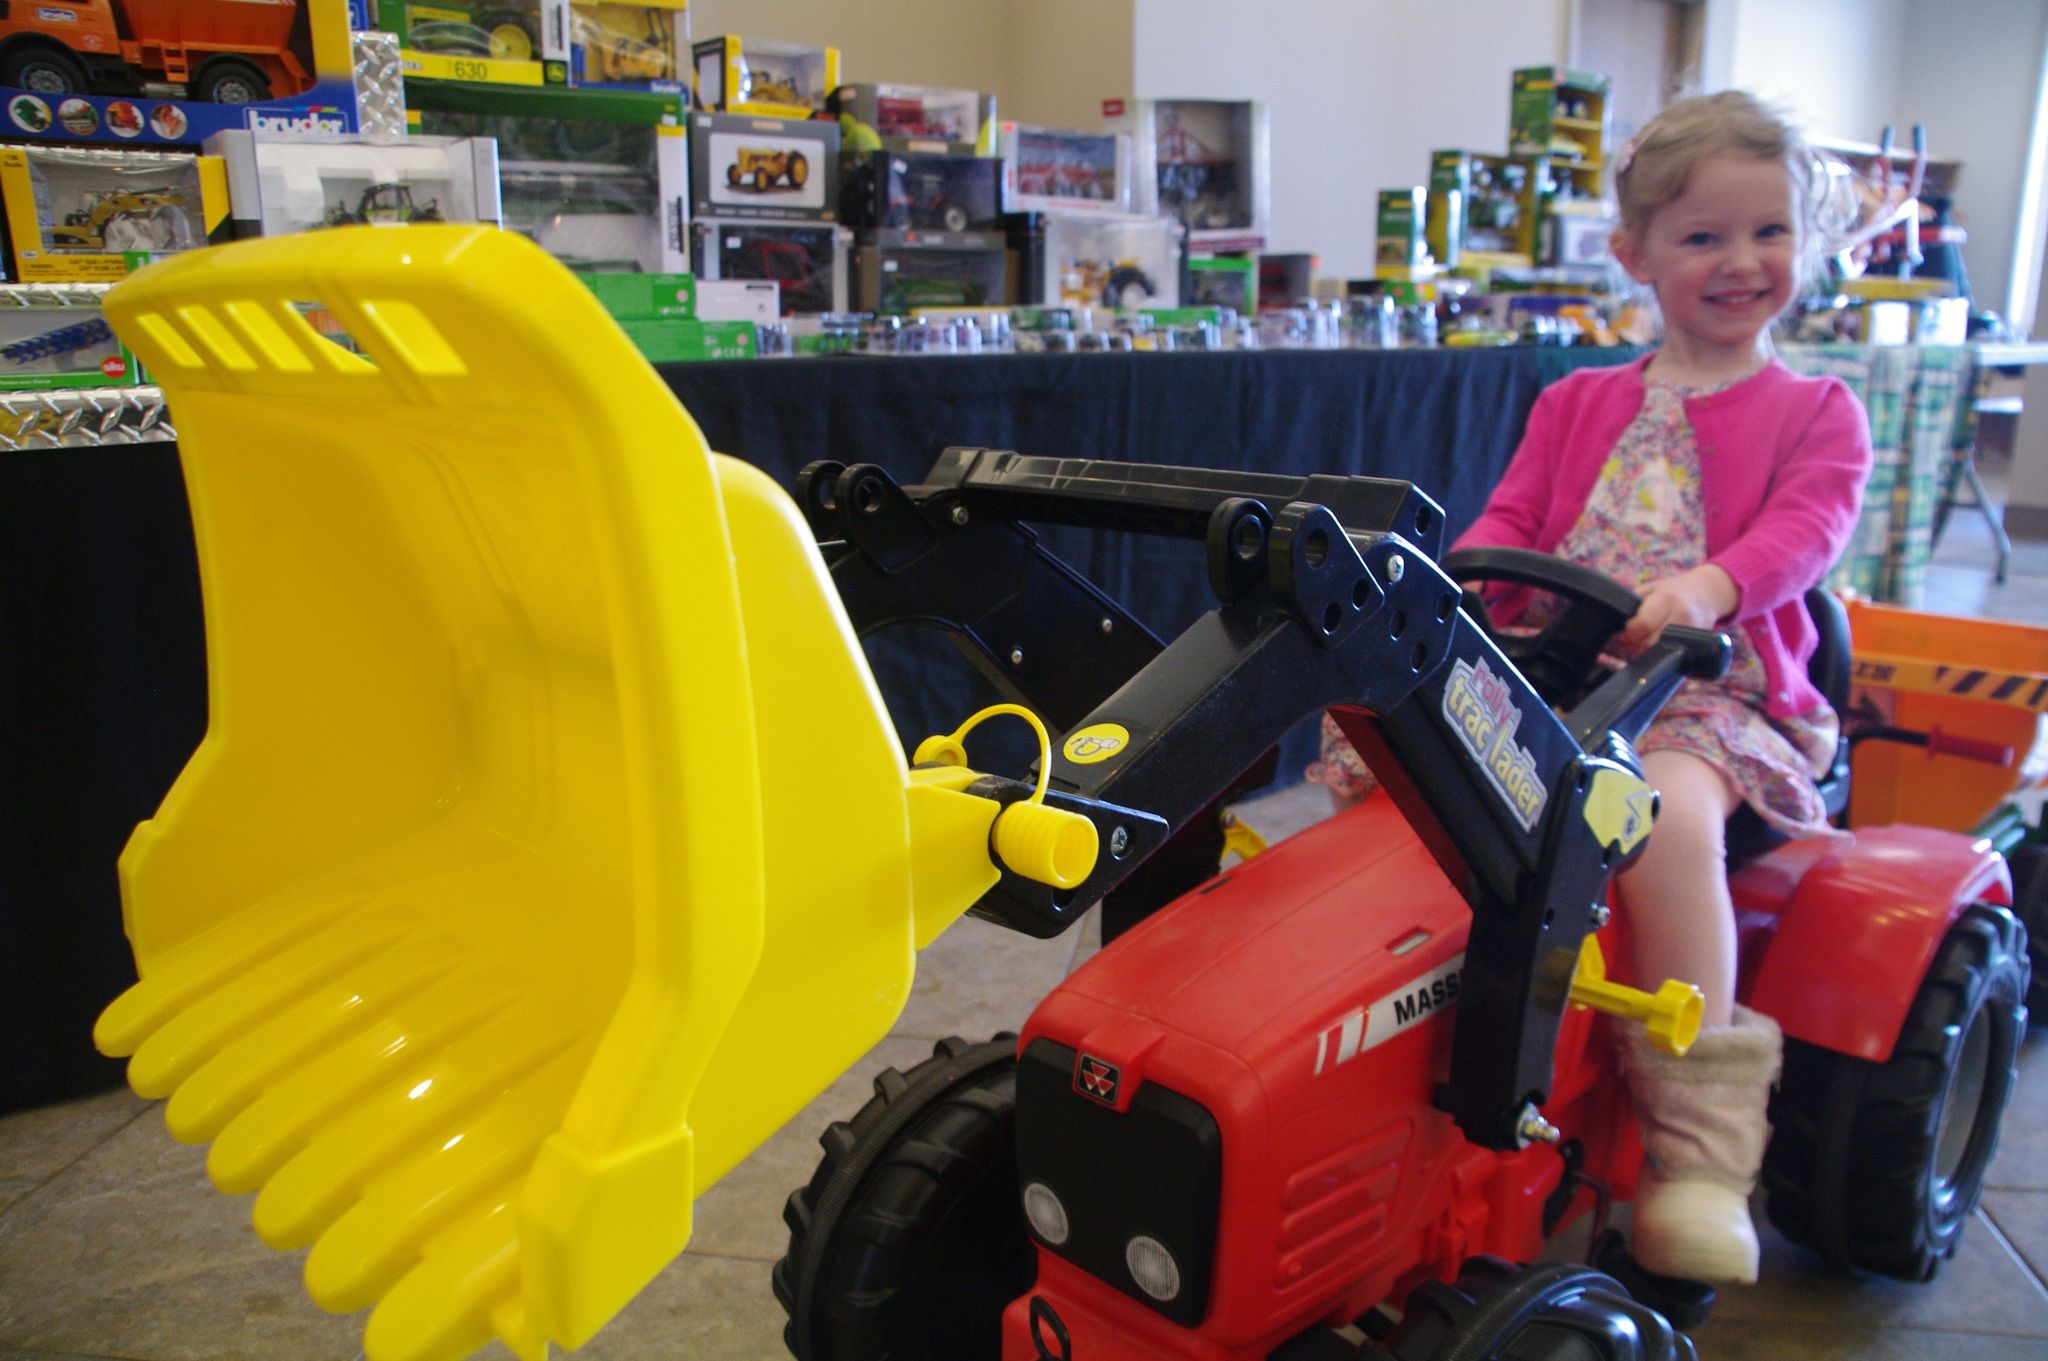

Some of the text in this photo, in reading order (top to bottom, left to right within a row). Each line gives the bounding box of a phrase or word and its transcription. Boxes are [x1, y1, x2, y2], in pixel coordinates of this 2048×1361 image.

[249, 110, 341, 133] bruder
[1450, 674, 1542, 817] trac lader
